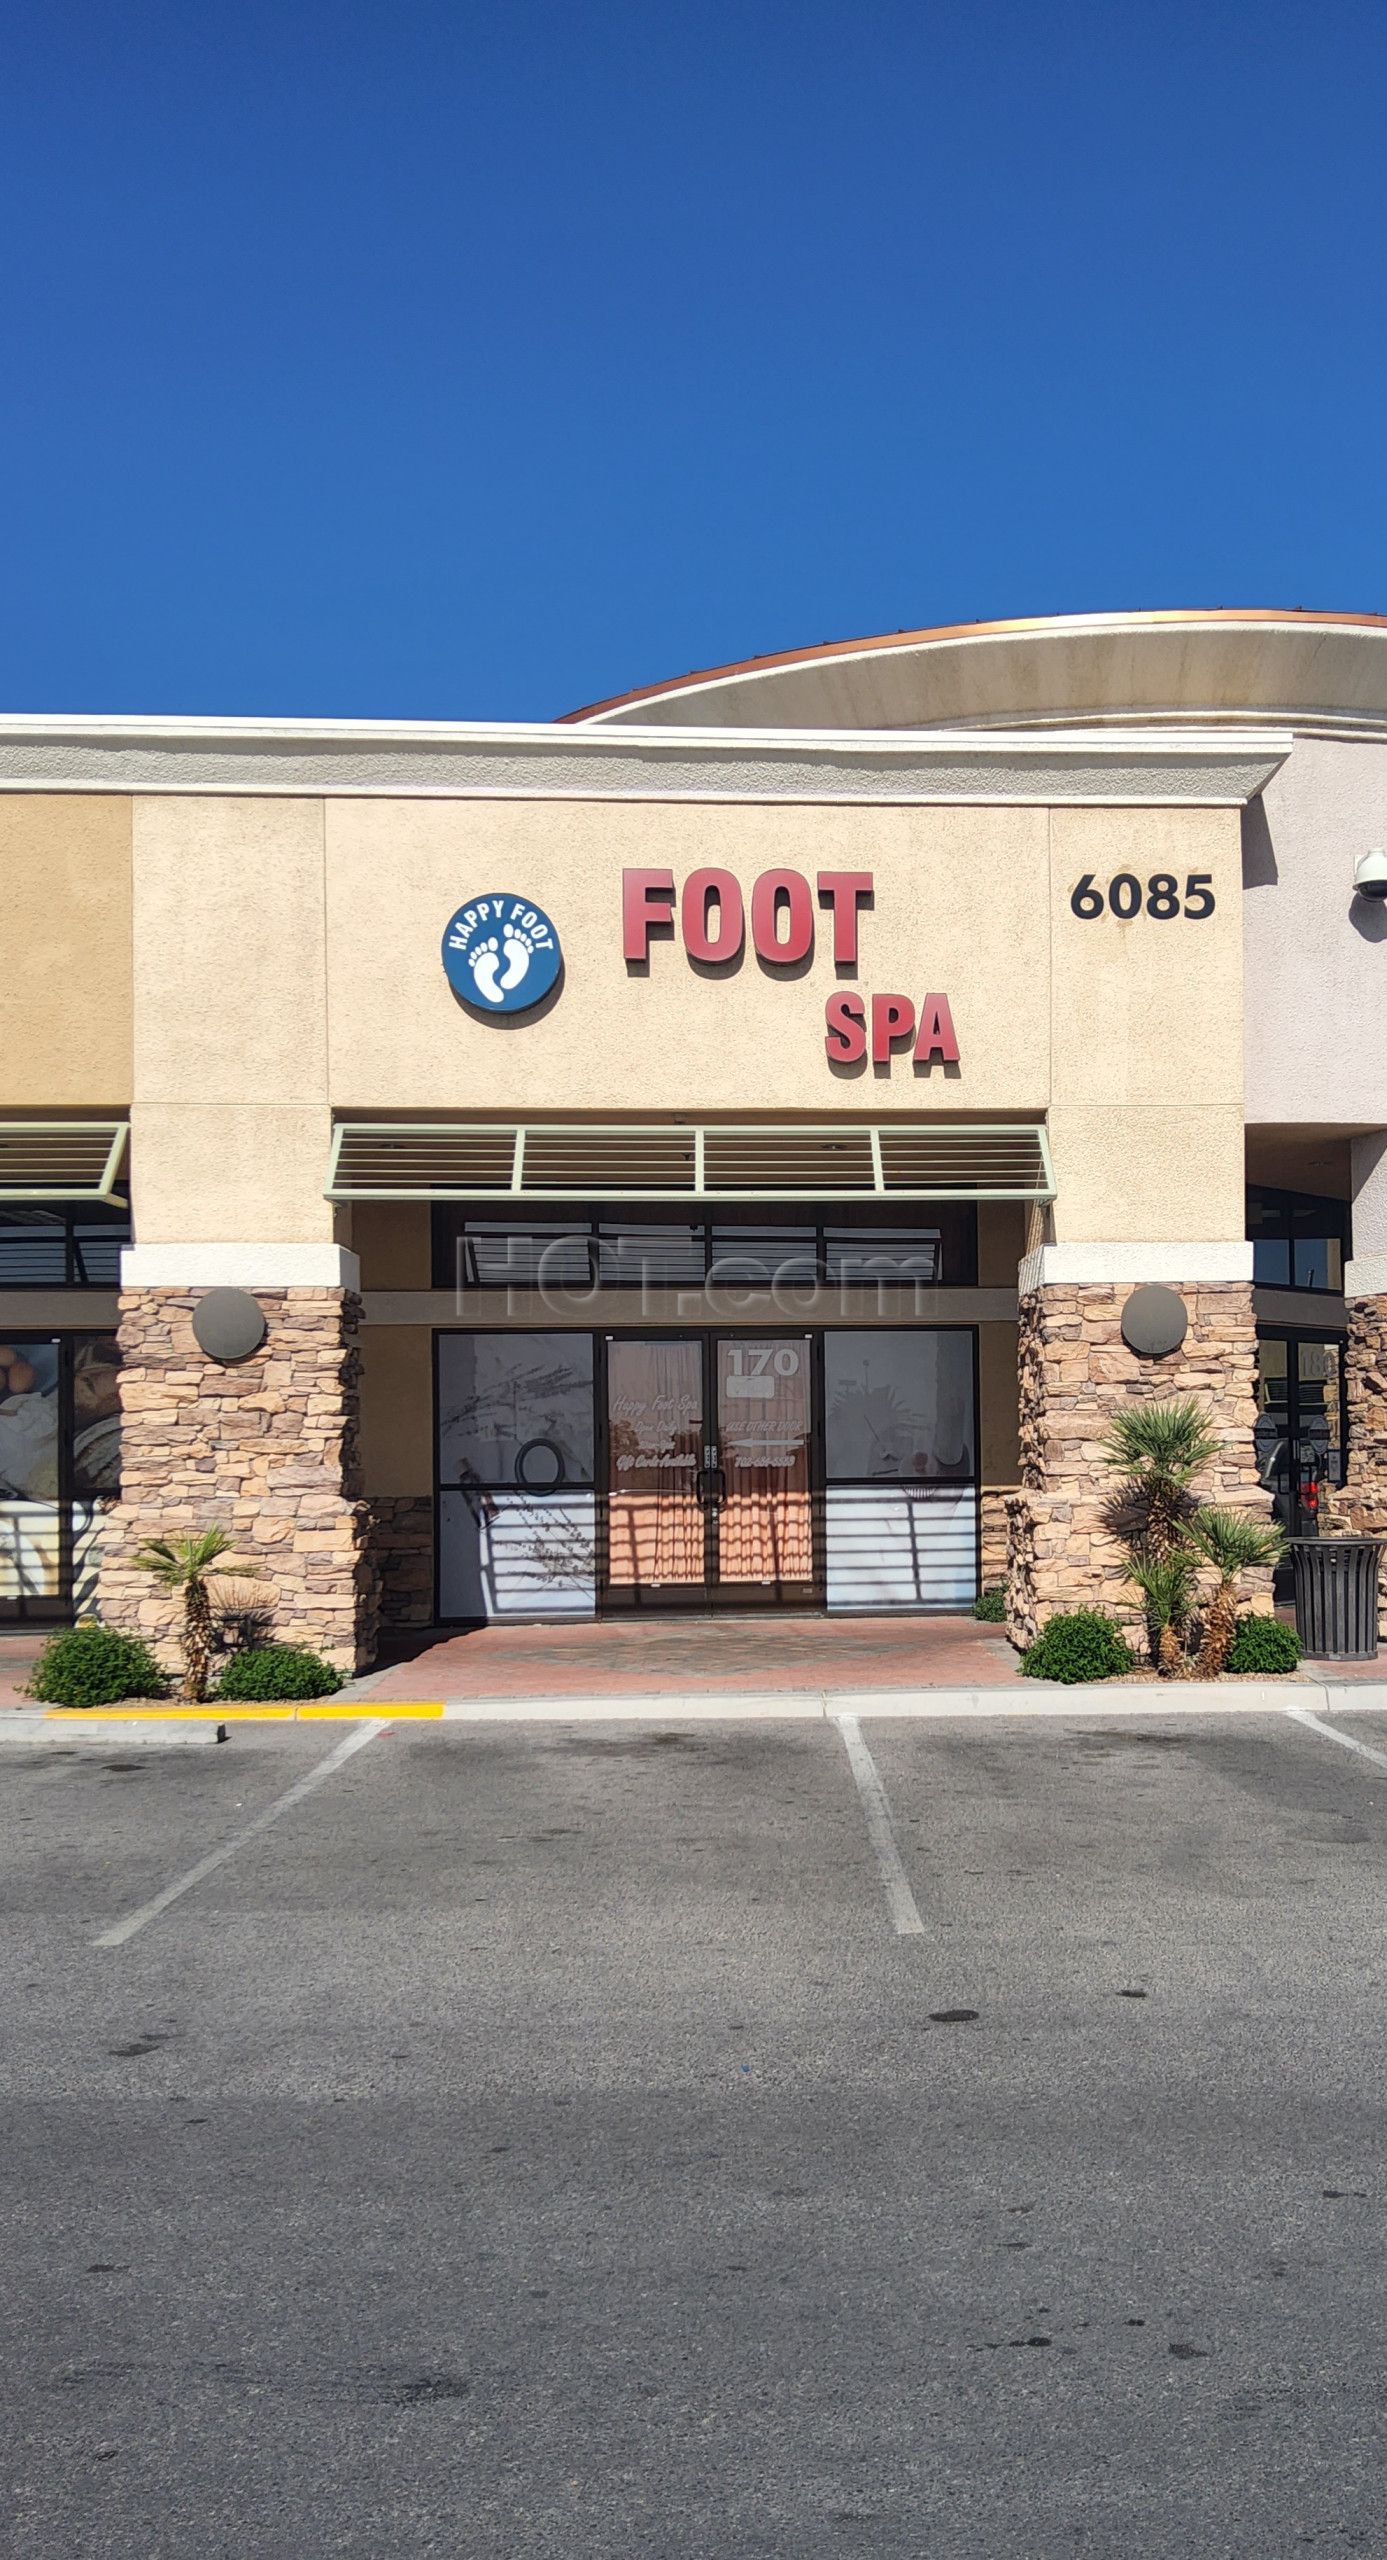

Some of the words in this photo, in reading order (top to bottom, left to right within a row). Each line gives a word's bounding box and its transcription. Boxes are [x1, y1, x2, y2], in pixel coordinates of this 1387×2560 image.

[623, 867, 874, 963] FOOT
[1070, 872, 1216, 920] 6085
[448, 899, 505, 951] HAPPY
[510, 903, 554, 950] FOOT
[825, 990, 961, 1063] SPA
[727, 1348, 800, 1376] 170
[1302, 1350, 1335, 1378] 180
[612, 1394, 646, 1416] Happy
[651, 1394, 675, 1411] Foot
[678, 1394, 698, 1415] Spa
[725, 1420, 747, 1433] USE
[746, 1420, 777, 1433] OTHER
[777, 1420, 803, 1433] DOOR
